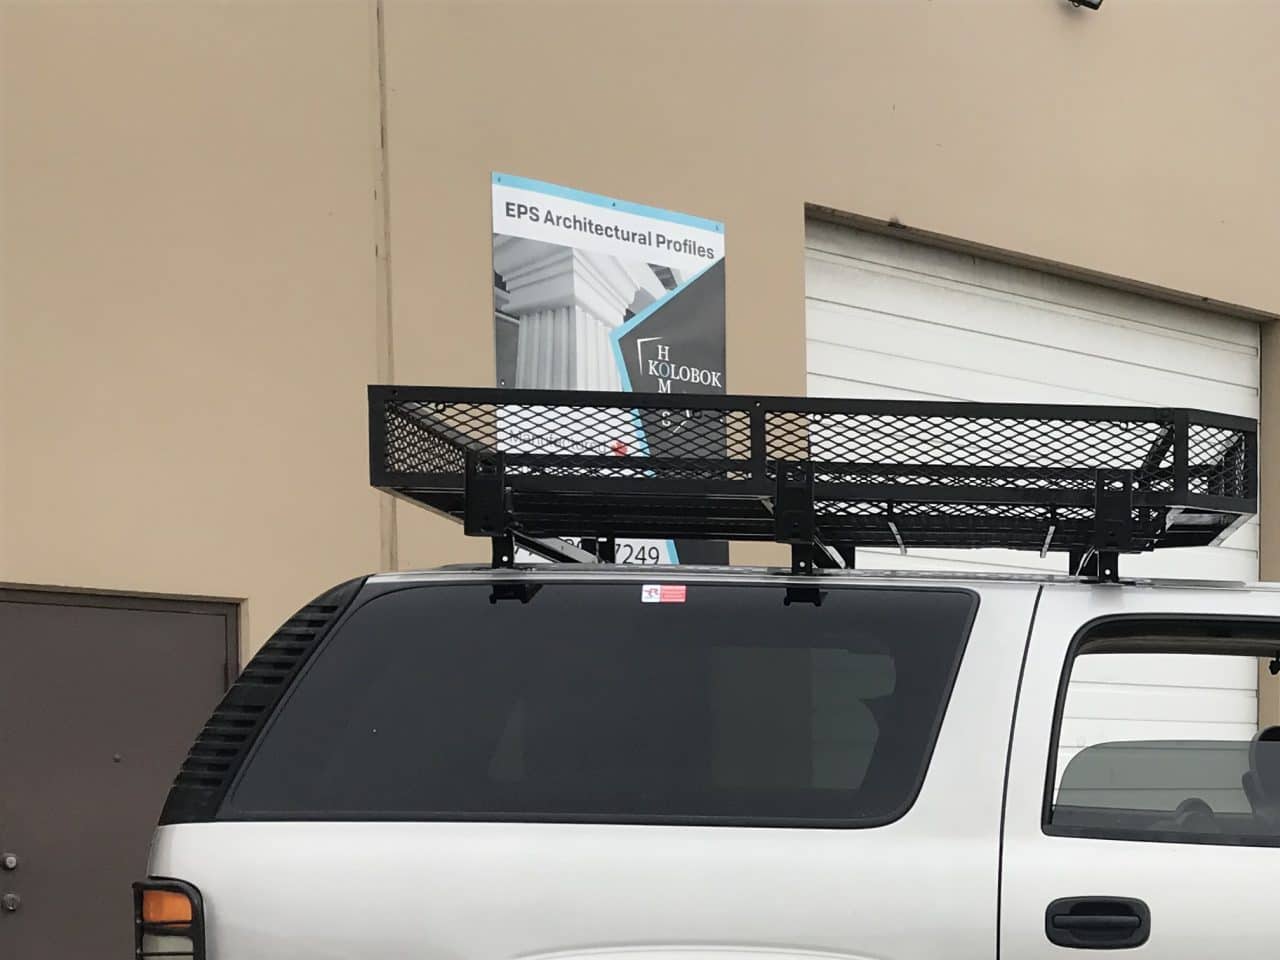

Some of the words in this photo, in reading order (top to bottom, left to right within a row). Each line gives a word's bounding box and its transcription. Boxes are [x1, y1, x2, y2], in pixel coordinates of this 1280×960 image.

[505, 201, 540, 223] EPS
[543, 209, 652, 246] Architectural
[655, 233, 715, 260] Profiles
[648, 359, 722, 388] KOLOBOK
